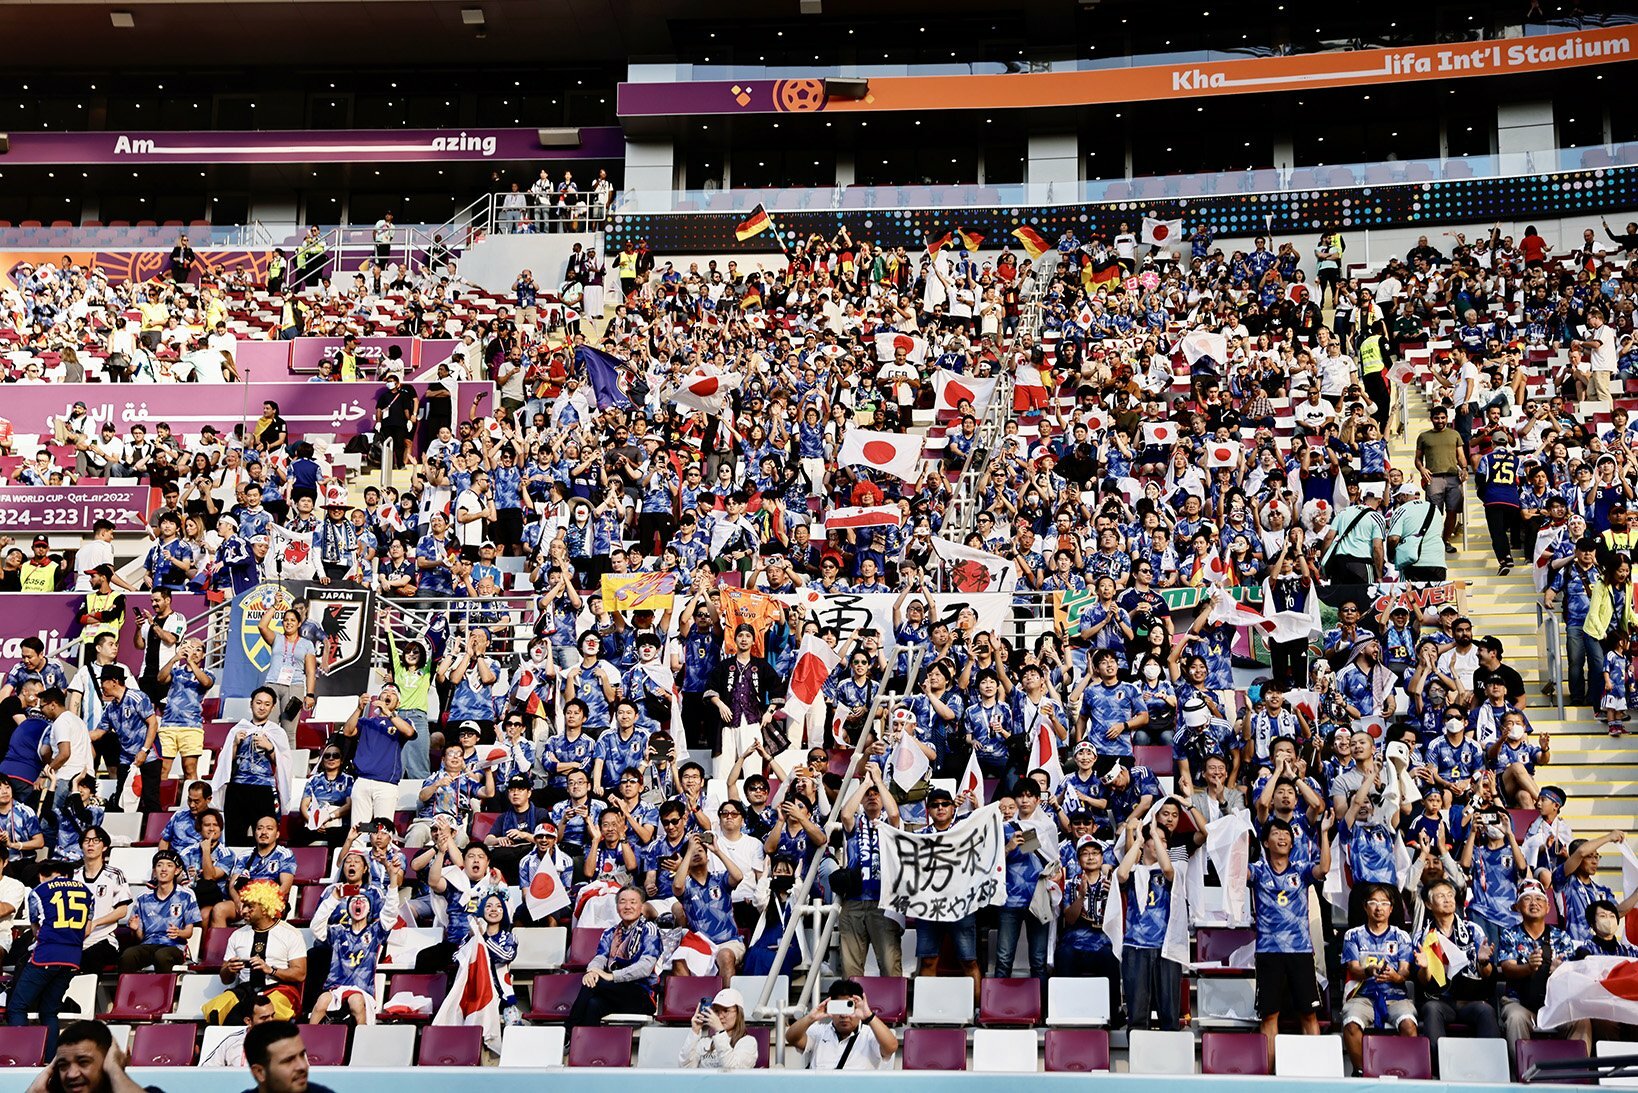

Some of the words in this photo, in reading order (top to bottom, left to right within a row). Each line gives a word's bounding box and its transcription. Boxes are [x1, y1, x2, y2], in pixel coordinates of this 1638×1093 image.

[1437, 46, 1501, 71] Int'l
[1507, 36, 1631, 66] Stadium
[13, 494, 45, 503] WORLD
[46, 494, 63, 503] CUP
[320, 592, 353, 600] JAPAN
[698, 648, 706, 659] 9
[582, 683, 592, 696] 9
[1451, 765, 1461, 778] 6
[892, 812, 999, 896] 勝利
[1277, 889, 1289, 907] 6
[50, 891, 88, 929] 15
